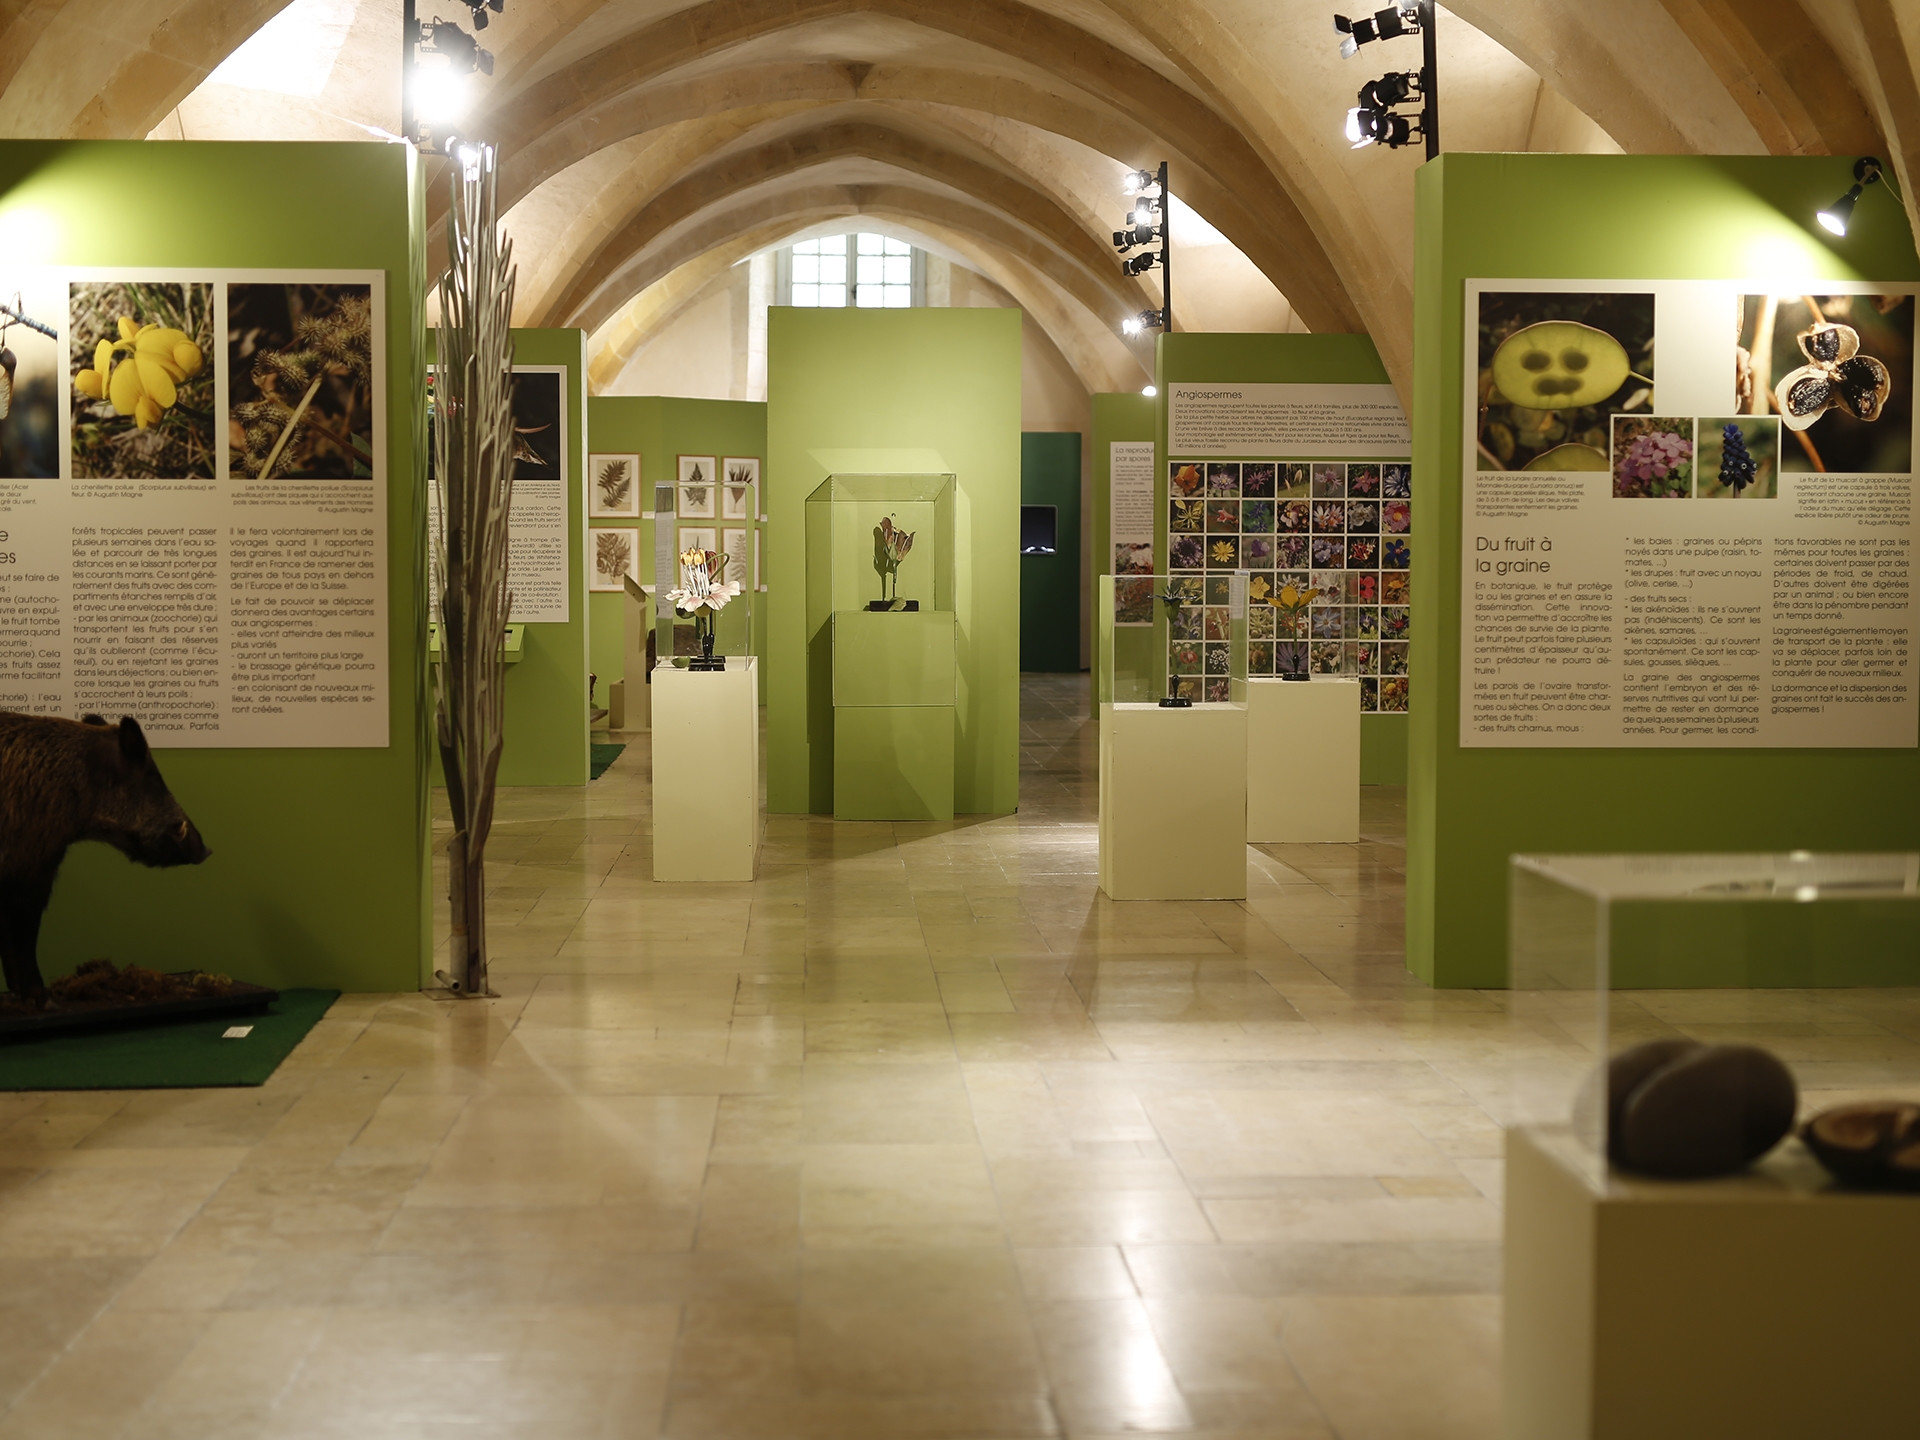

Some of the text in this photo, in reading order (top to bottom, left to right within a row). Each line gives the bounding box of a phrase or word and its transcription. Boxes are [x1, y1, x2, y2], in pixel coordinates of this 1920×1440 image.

[1176, 390, 1242, 400] Angiospermes
[72, 526, 217, 537] forêts tropicales peuvent passer
[72, 537, 108, 548] plusieurs
[111, 537, 152, 546] semaines
[154, 537, 176, 546] dans
[1476, 536, 1552, 551] Du fruit à
[1774, 536, 1794, 545] tions
[1796, 536, 1842, 545] favorables
[1859, 536, 1877, 545] sont
[1880, 539, 1896, 547] pas
[1899, 536, 1910, 545] les
[72, 548, 217, 559] lée et parcourir de très longues
[1625, 546, 1651, 558] noyés
[1652, 546, 1674, 555] dans
[1694, 546, 1719, 558] pulpe
[1750, 546, 1762, 555] to-
[230, 559, 254, 568] terdit
[269, 559, 301, 568] France
[302, 559, 316, 568] de
[357, 559, 374, 568] des
[1476, 559, 1551, 575] la graine
[1773, 557, 1910, 568] certaines doivent passer par des
[25, 572, 45, 581] faire
[47, 572, 60, 581] de
[230, 596, 241, 605] Le
[245, 596, 260, 605] fait
[264, 596, 277, 605] de
[280, 596, 315, 608] pouvoir
[332, 596, 374, 608] déplacer
[1545, 602, 1570, 610] Cette
[1580, 602, 1613, 610] innova-
[1, 616, 60, 625] le fruit tombe
[73, 624, 128, 635] transportent
[132, 624, 145, 633] les
[149, 624, 170, 633] fruits
[173, 626, 195, 635] pour
[1474, 623, 1512, 632] chances
[1514, 623, 1527, 632] de
[1529, 623, 1554, 632] survie
[1556, 623, 1568, 632] de
[1570, 623, 1579, 632] la
[1475, 633, 1612, 644] Le fruit peut parfois faire plusieurs
[12, 659, 33, 668] fruits
[21, 670, 61, 679] facilitant
[1623, 672, 1760, 683] La graine des angiospermes
[1623, 703, 1651, 712] mettre
[1655, 703, 1667, 712] de
[1671, 703, 1695, 712] rester
[1713, 703, 1759, 712] dormance
